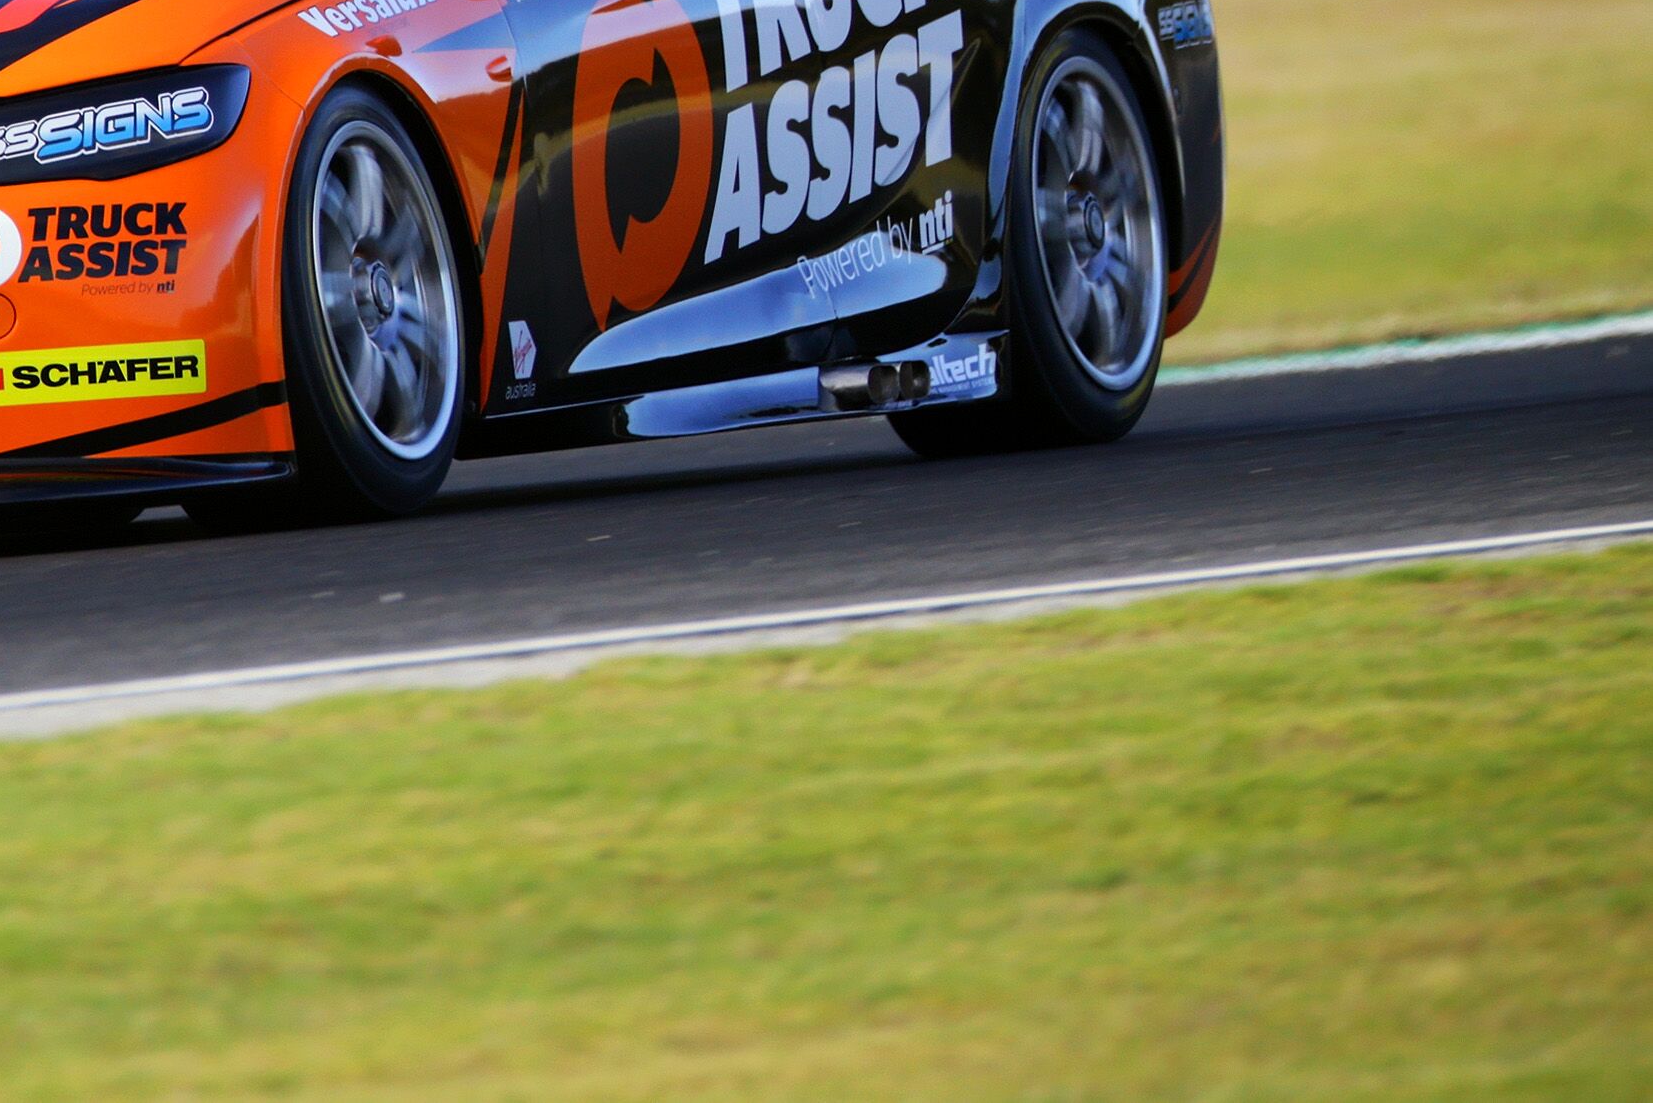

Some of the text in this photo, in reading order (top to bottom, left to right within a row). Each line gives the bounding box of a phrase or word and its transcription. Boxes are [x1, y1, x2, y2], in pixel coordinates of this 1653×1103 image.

[704, 8, 964, 265] ASSIST
[28, 202, 187, 242] TRUCK
[18, 239, 187, 283] ASSIST
[797, 189, 954, 299] Powered by nti
[81, 279, 176, 297] Powered by nti
[12, 355, 199, 390] SCHÄFER
